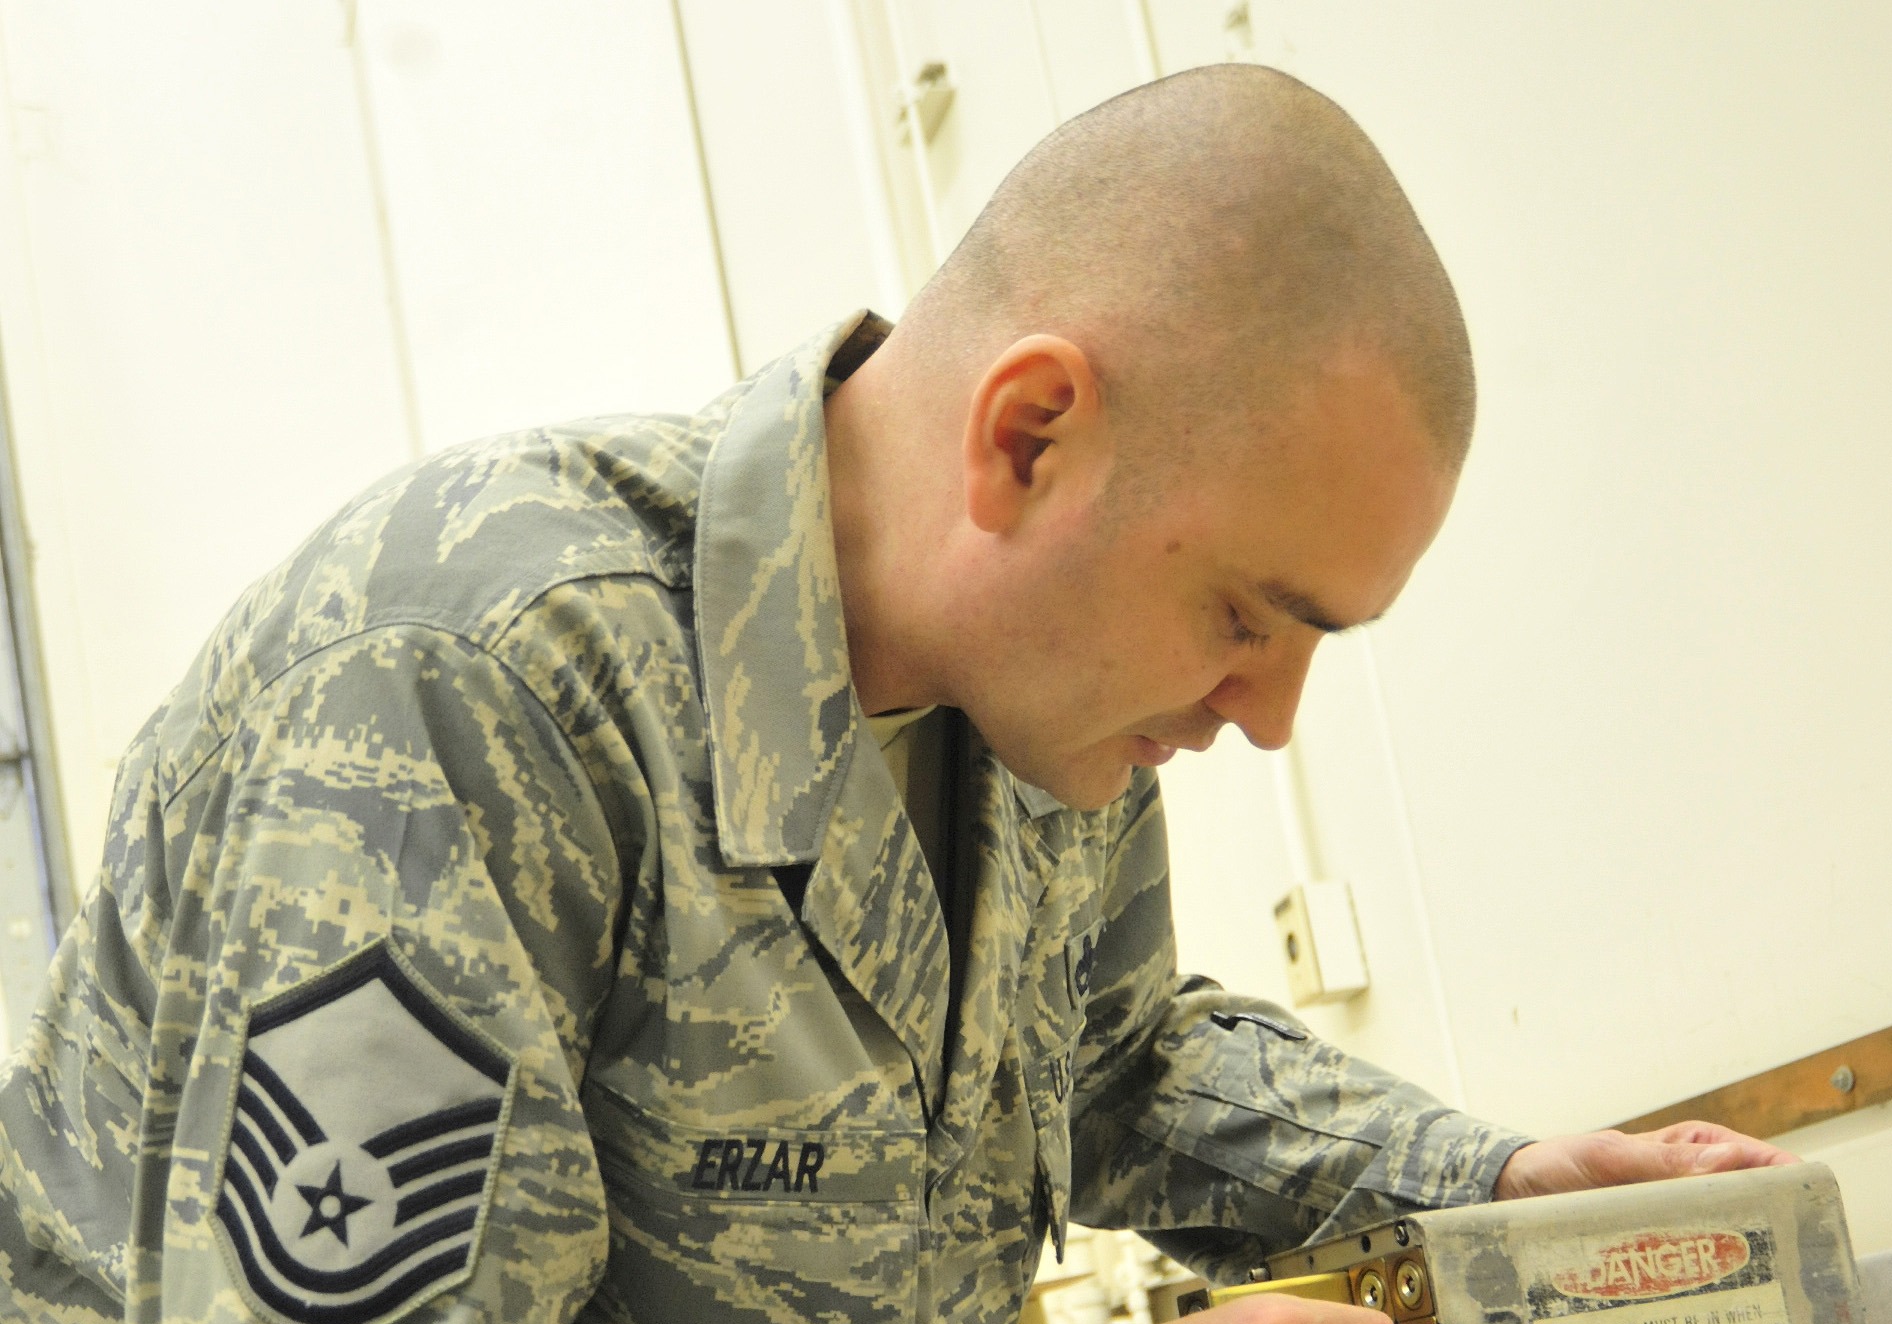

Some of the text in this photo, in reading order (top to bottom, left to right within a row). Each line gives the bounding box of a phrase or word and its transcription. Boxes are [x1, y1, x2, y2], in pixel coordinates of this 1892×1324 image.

[691, 1138, 825, 1193] ERZAR
[1584, 1238, 1721, 1290] DANGER
[1725, 1304, 1762, 1324] WHEN
